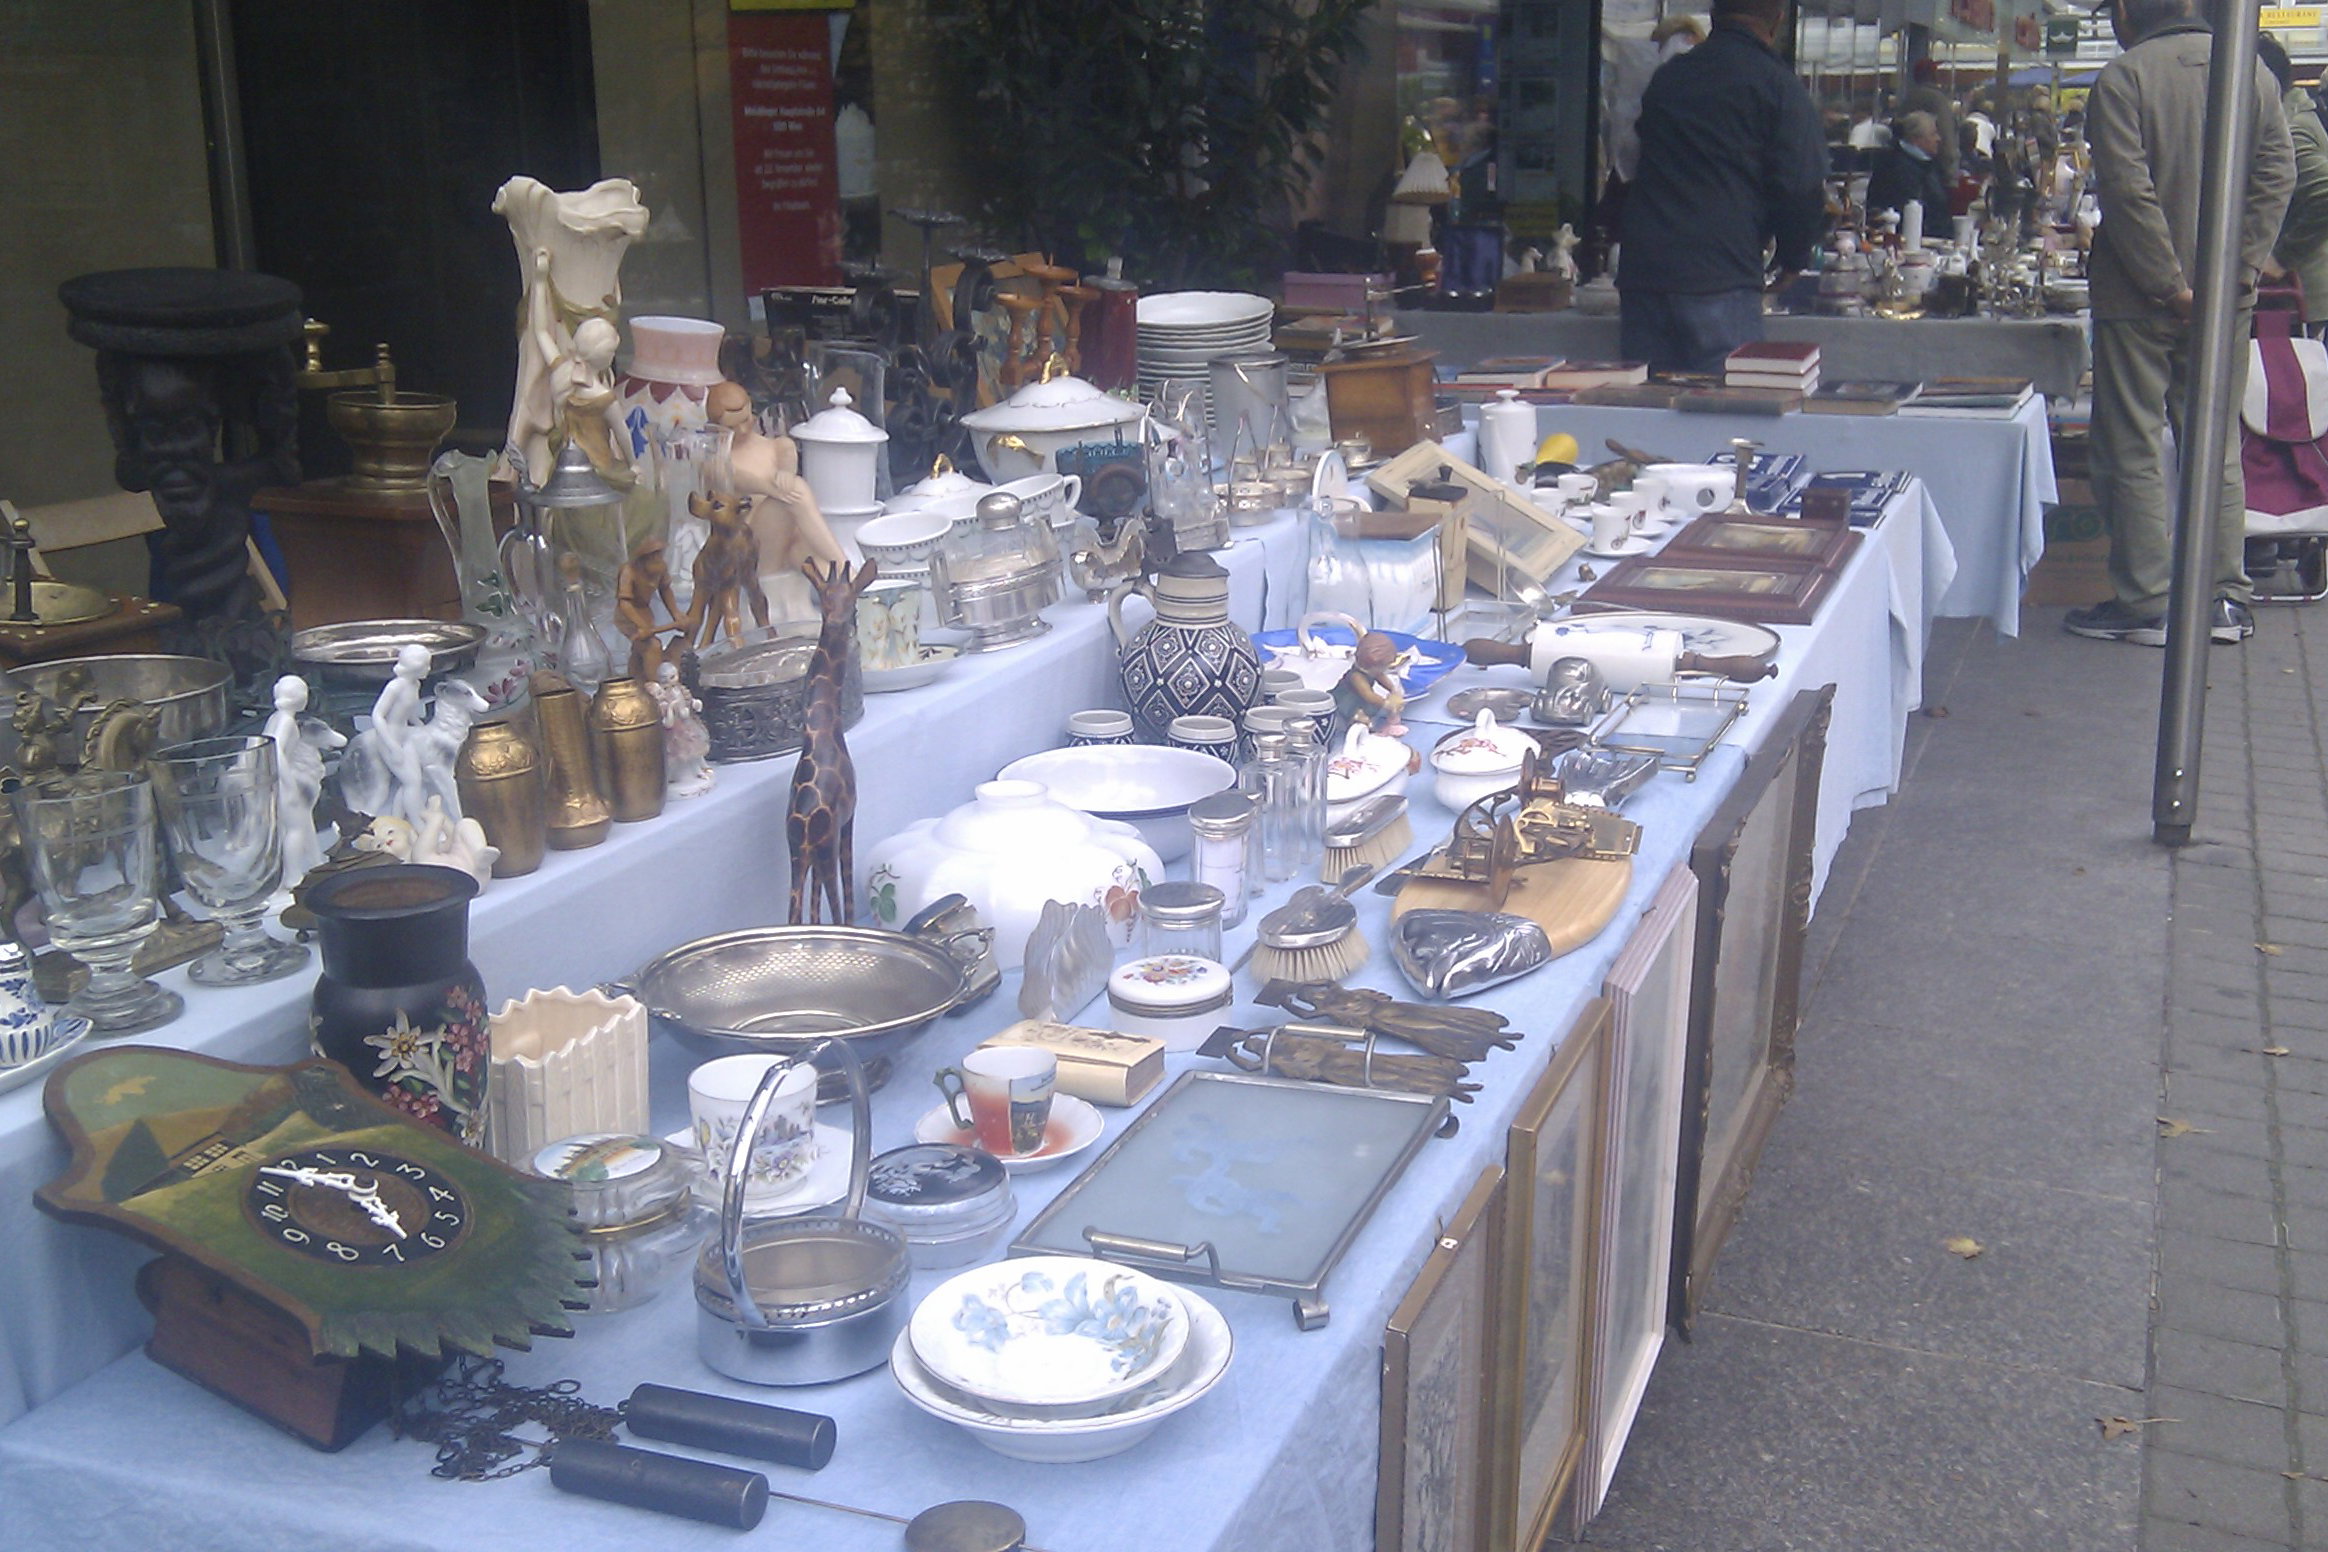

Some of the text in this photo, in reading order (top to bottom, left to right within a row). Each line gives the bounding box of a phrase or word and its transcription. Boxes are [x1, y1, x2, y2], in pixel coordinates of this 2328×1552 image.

[316, 1152, 336, 1164] 1
[349, 1152, 379, 1168] 2
[395, 1162, 426, 1180] 3
[256, 1180, 284, 1196] 11
[428, 1185, 455, 1202] 4
[260, 1203, 289, 1222] 10
[434, 1210, 460, 1226] 5
[282, 1227, 310, 1244] 9
[420, 1231, 445, 1249] 6
[325, 1241, 359, 1261] 8
[382, 1242, 405, 1262] 7
